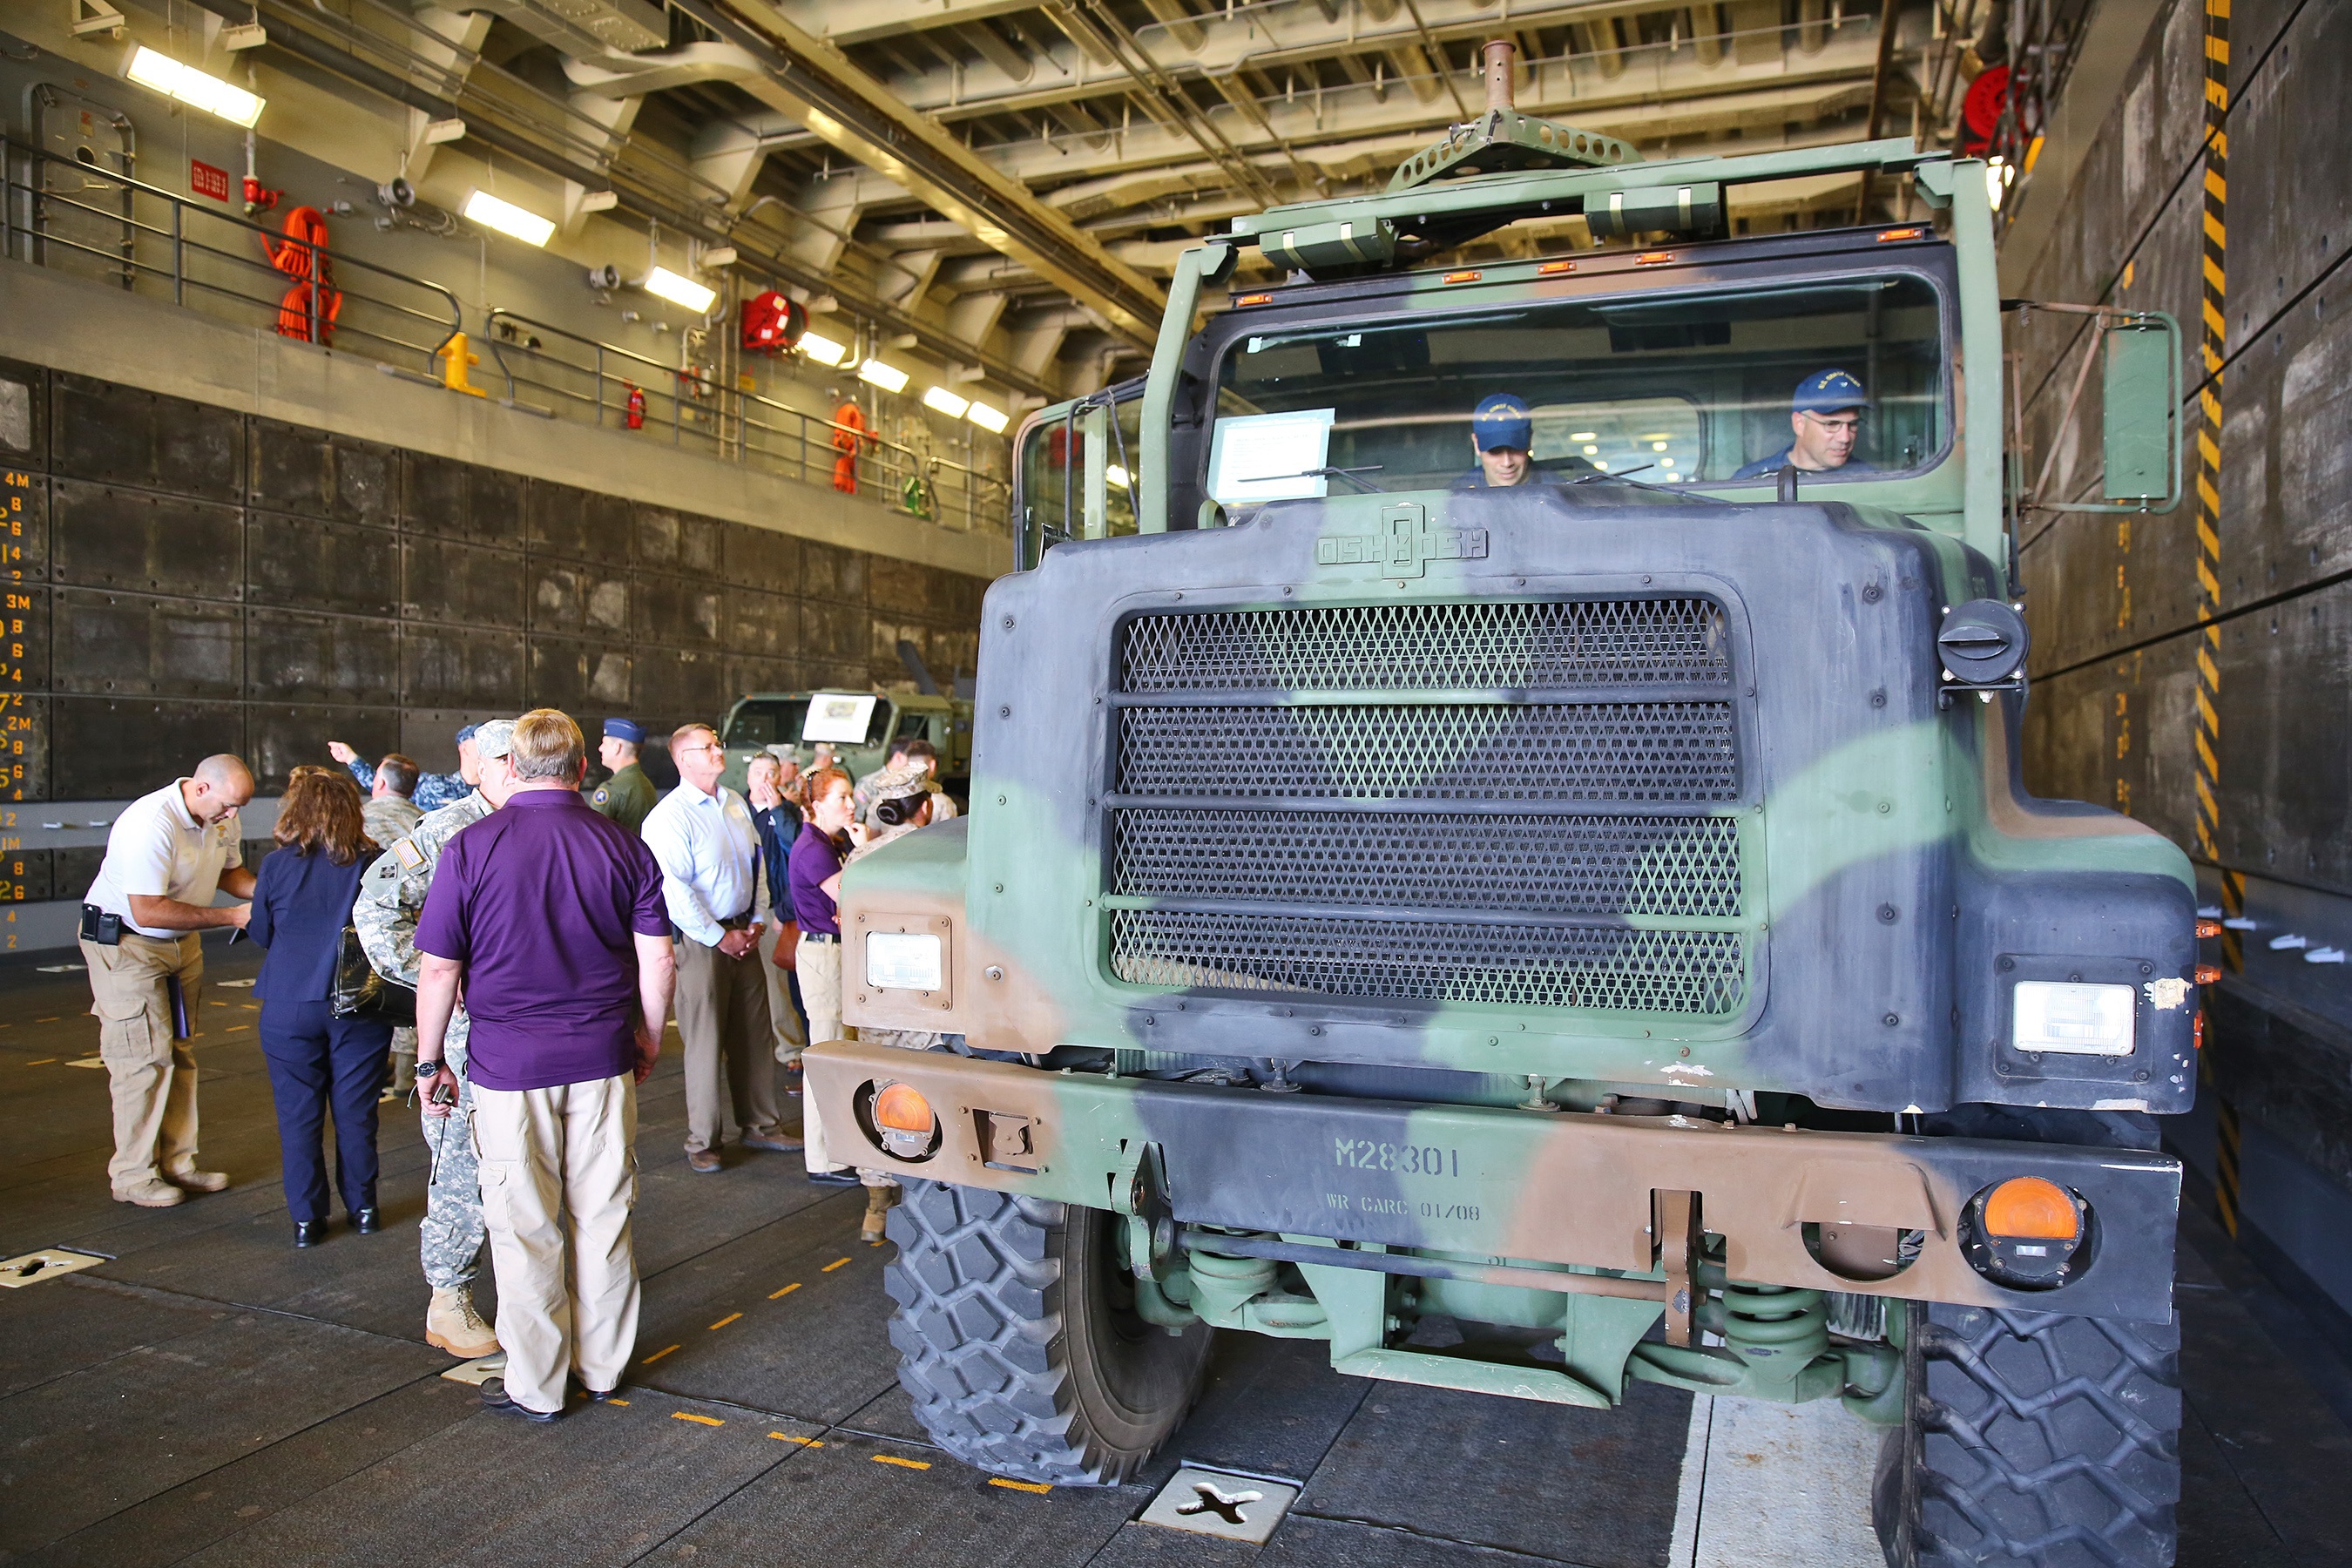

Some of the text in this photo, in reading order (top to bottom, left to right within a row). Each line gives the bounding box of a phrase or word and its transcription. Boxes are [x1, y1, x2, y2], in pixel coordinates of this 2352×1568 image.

[4, 471, 29, 488] 4M
[10, 496, 22, 511] 8
[10, 521, 22, 536] 6
[10, 546, 21, 560] 4
[6, 594, 30, 609] 3M
[12, 618, 23, 633] 8
[12, 643, 23, 658] 6
[11, 668, 22, 682] 4
[12, 693, 23, 706] 2
[7, 716, 30, 731] 2M
[13, 740, 23, 755] 8
[13, 765, 23, 779] 6
[6, 812, 16, 826] 2
[2, 838, 20, 850] 1M
[14, 862, 24, 875] 8
[14, 885, 24, 900] 6
[7, 910, 16, 923] 4
[7, 935, 17, 948] 2
[1335, 1138, 1458, 1177] M28301
[1326, 1193, 1480, 1221] WR CARC 01/08
